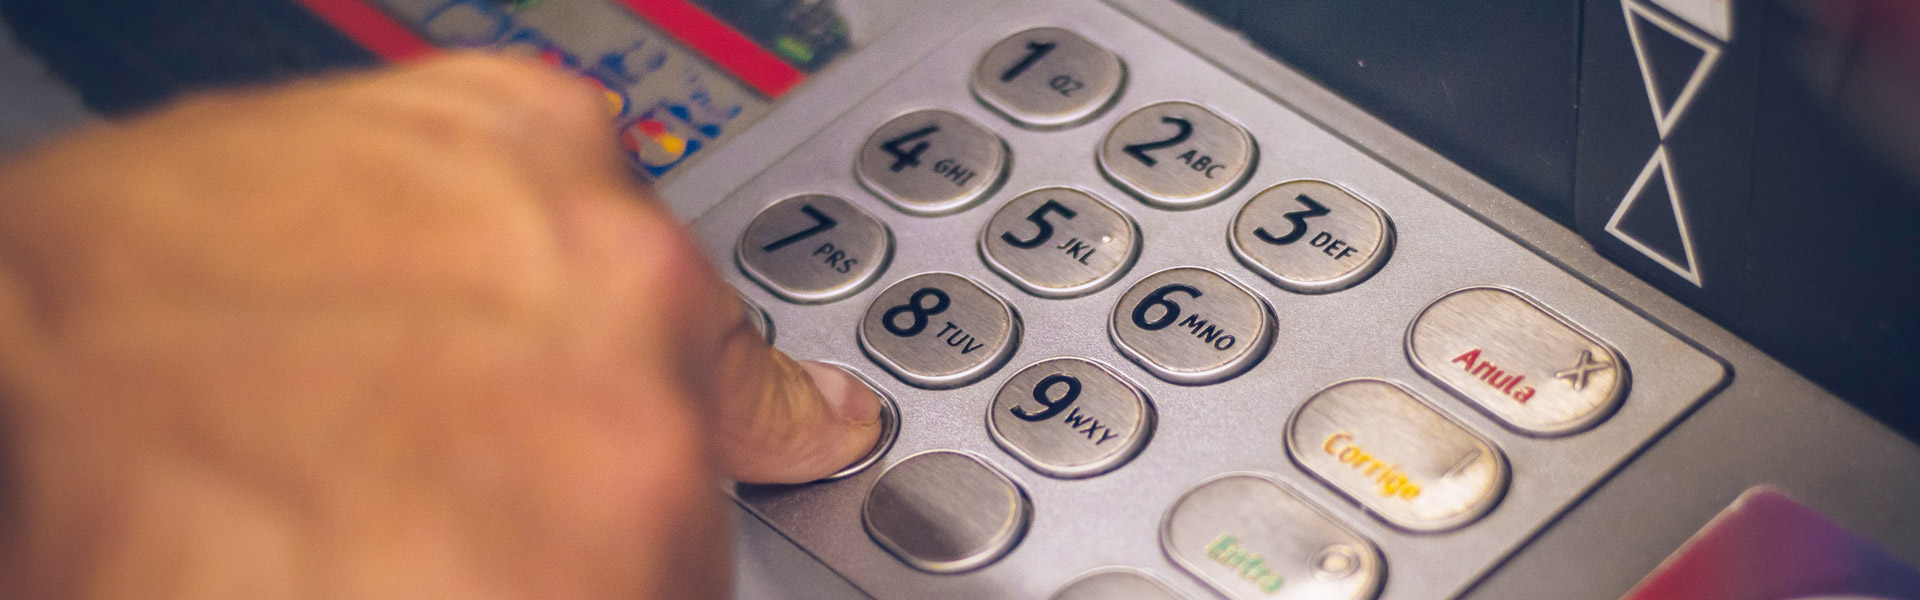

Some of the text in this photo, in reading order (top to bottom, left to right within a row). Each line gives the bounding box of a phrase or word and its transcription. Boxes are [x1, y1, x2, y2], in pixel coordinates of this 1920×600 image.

[1001, 42, 1056, 82] 1
[880, 124, 977, 189] 4 GHI
[1122, 116, 1226, 180] 2 ABC
[762, 205, 858, 275] 7 PRS
[1000, 199, 1098, 267] 5 JKL
[1253, 194, 1359, 261] 3 DEF
[882, 286, 984, 356] 8 TUV
[1132, 283, 1236, 351] 6 MNO
[1010, 372, 1119, 446] 9 WXY
[1452, 348, 1536, 405] Anula
[1323, 432, 1421, 501] Corrige
